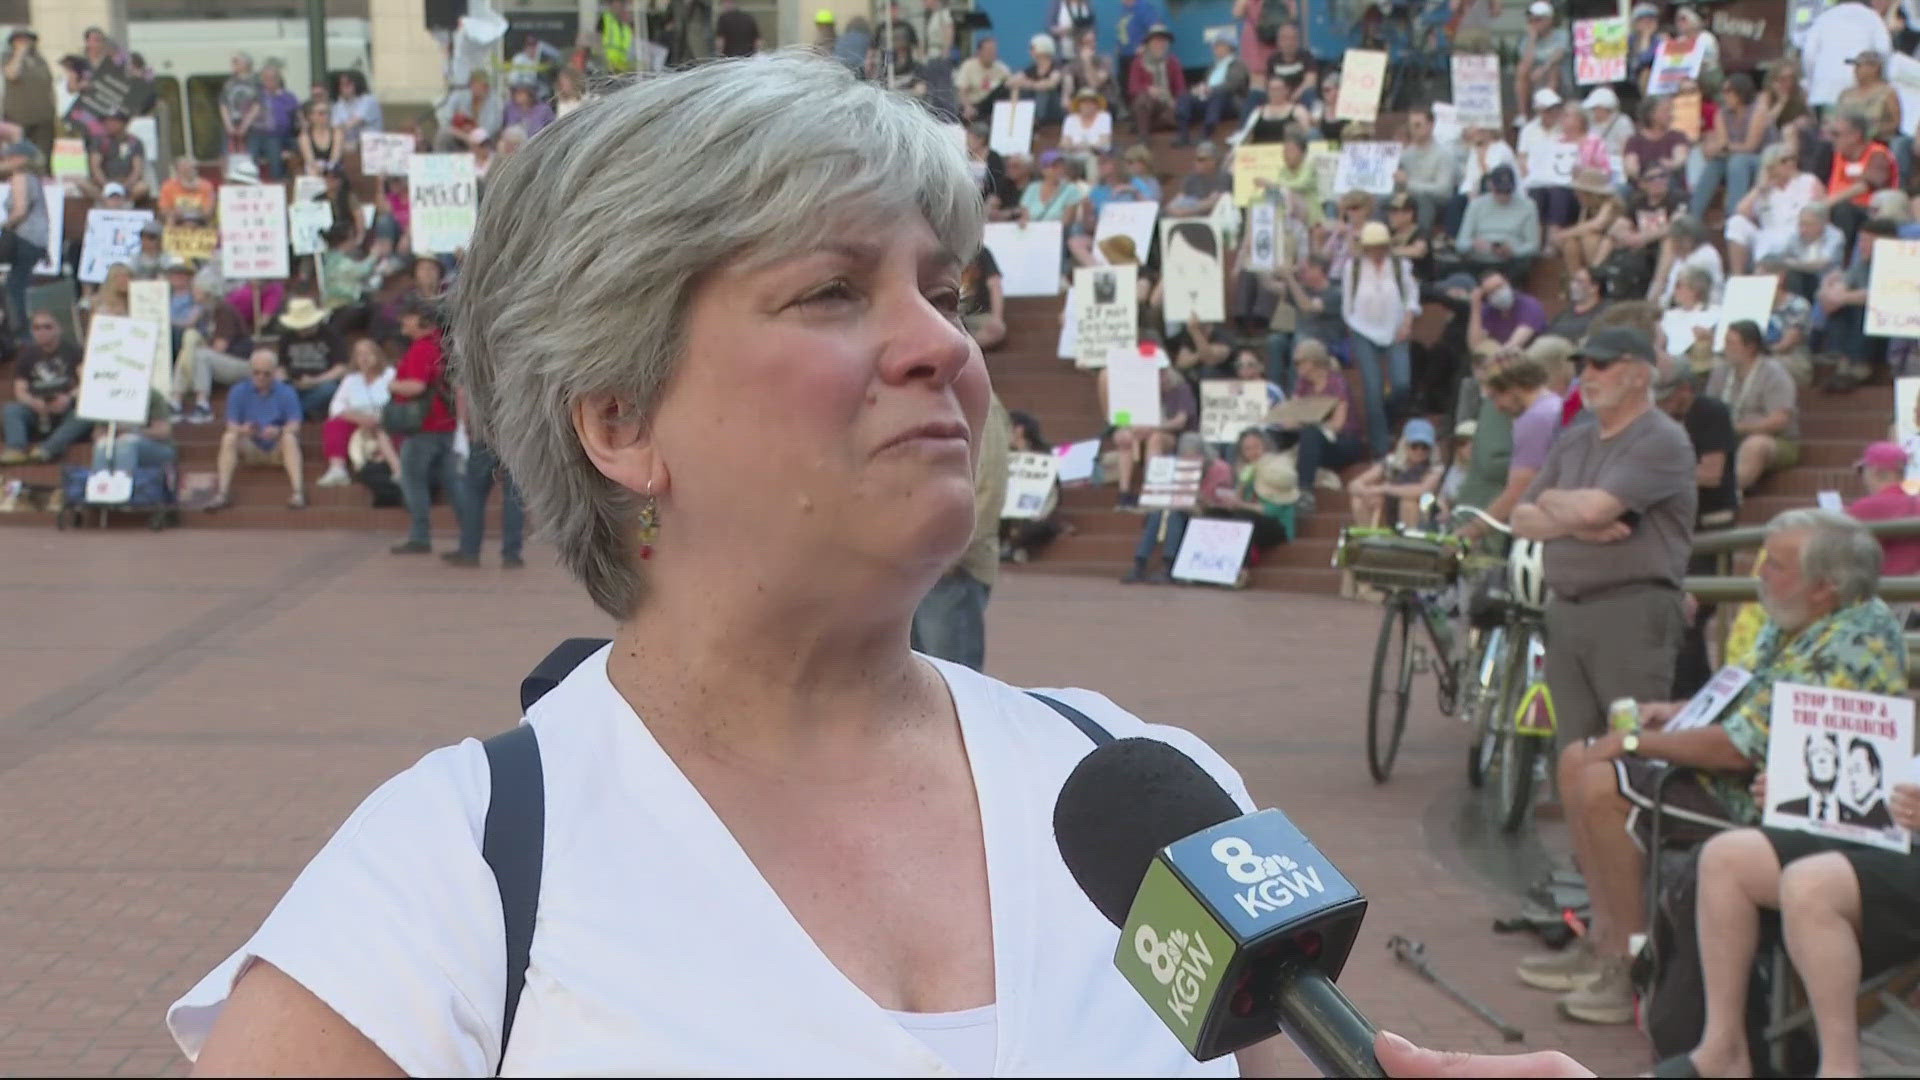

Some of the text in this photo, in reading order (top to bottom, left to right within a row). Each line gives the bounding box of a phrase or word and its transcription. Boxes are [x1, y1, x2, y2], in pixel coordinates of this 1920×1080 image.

[1792, 690, 1827, 709] STOP
[1832, 695, 1875, 715] TRUMP
[1792, 709, 1817, 726] THE
[1211, 837, 1266, 885] 8
[1233, 866, 1325, 919] KGW
[1134, 924, 1179, 985] 8
[1167, 930, 1214, 1027] KGW
